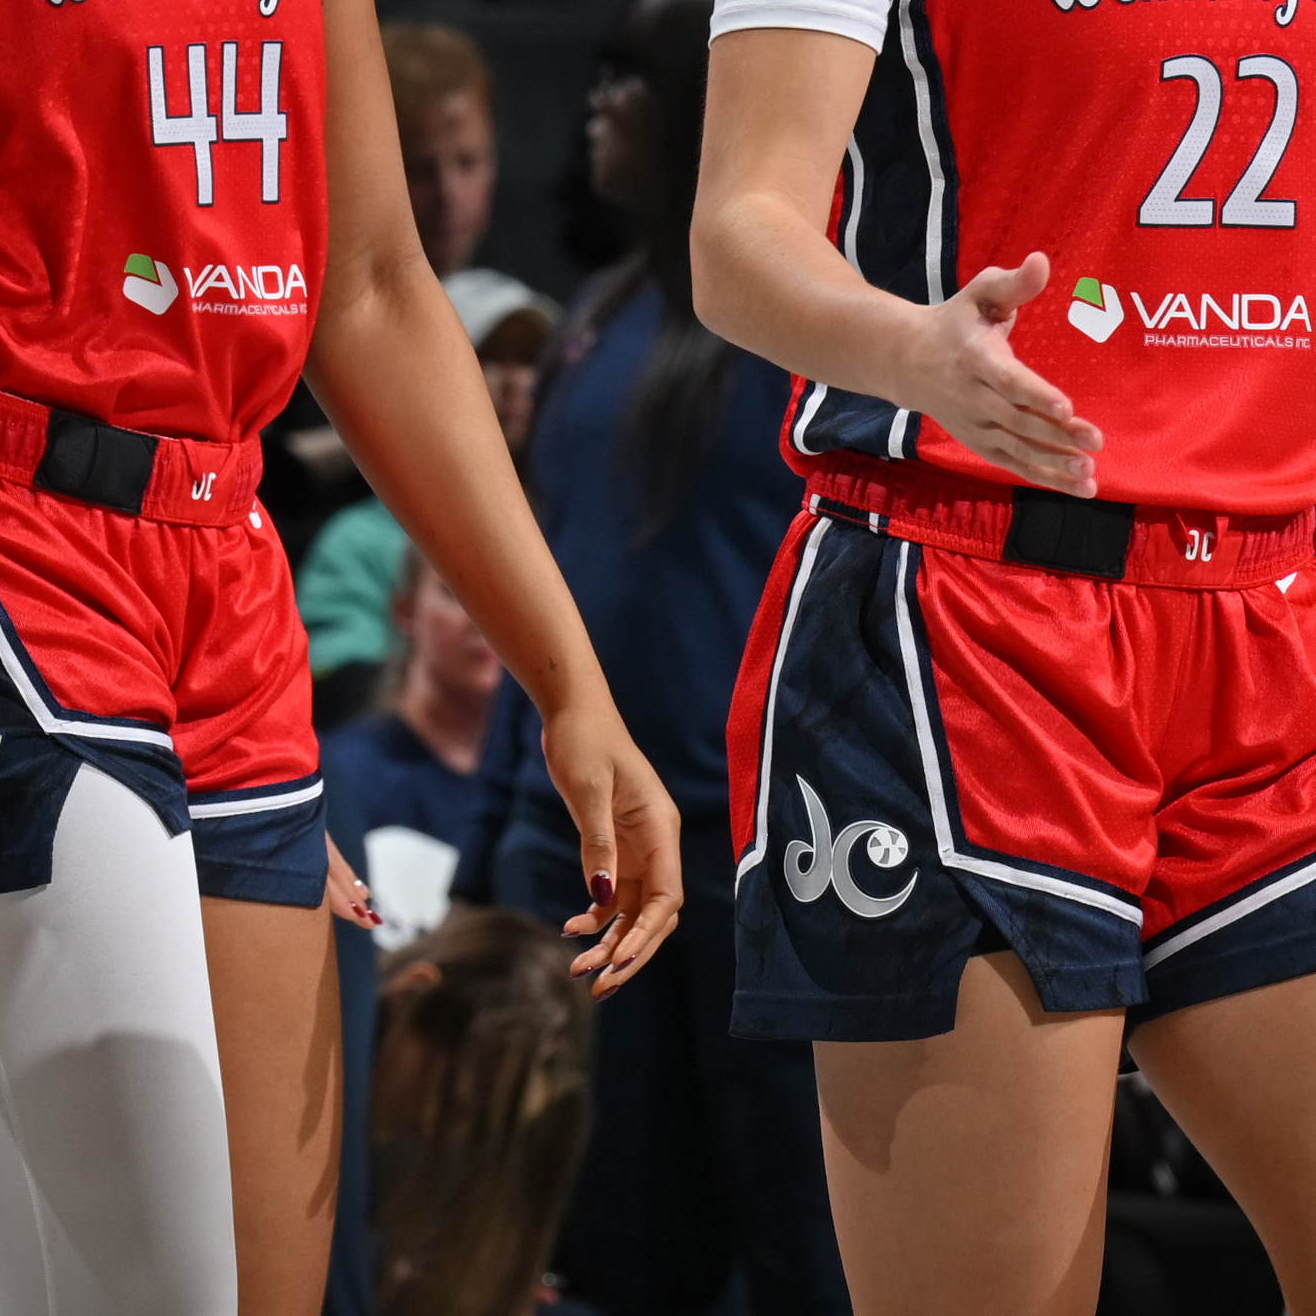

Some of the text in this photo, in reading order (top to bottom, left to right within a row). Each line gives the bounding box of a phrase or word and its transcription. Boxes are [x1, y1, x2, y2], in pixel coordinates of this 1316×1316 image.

[147, 41, 287, 207] 44
[1136, 54, 1299, 229] 22
[183, 264, 308, 300] VANDA
[1130, 291, 1312, 332] VANDA
[1144, 335, 1293, 349] PHARMACEUTICALS
